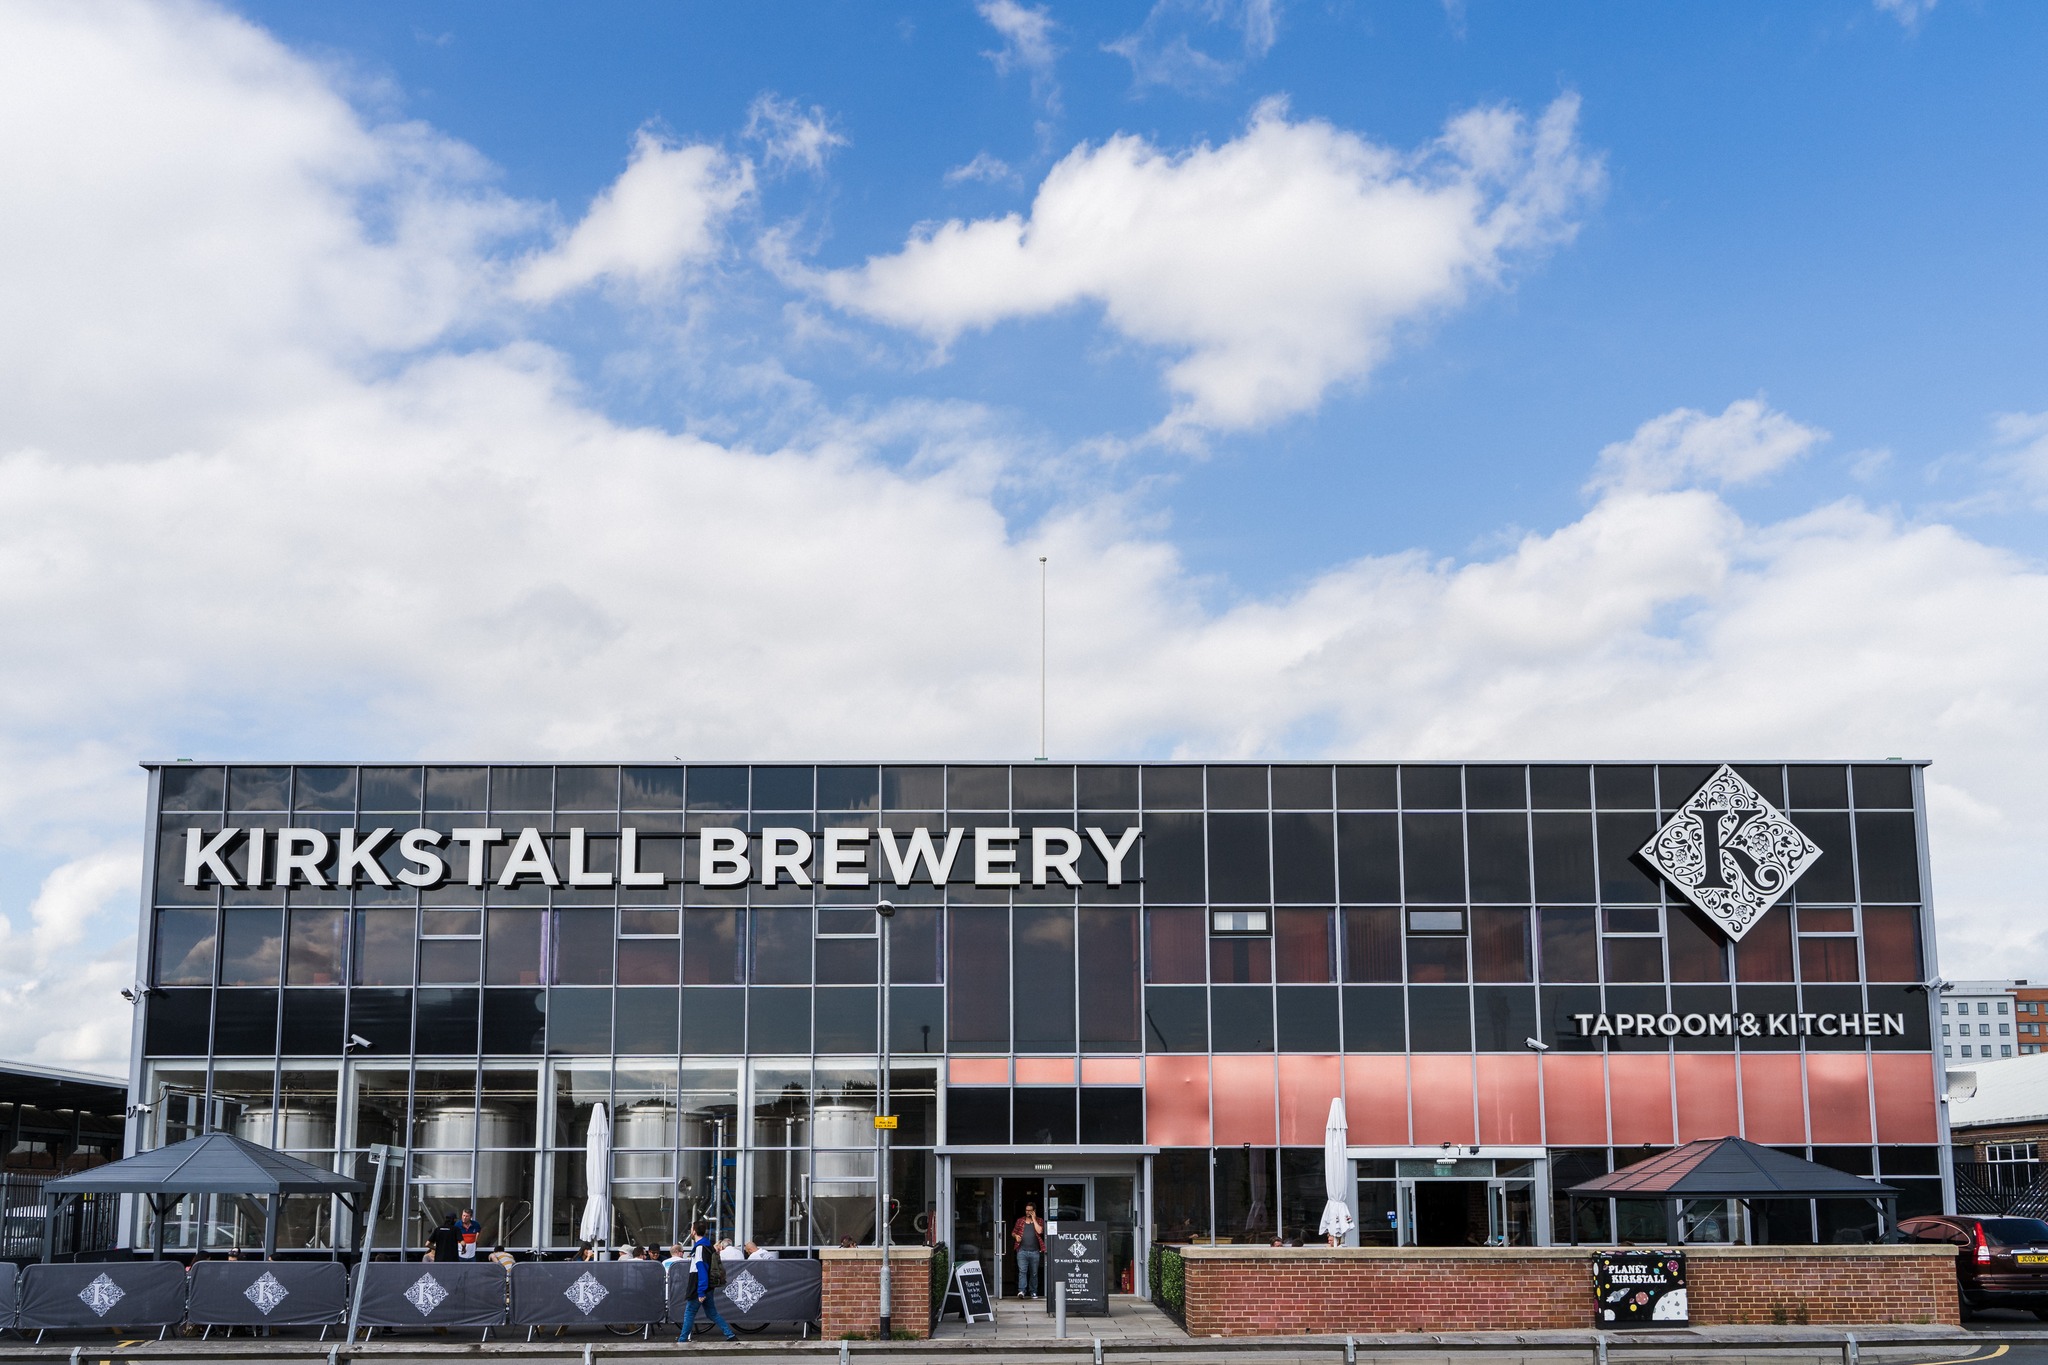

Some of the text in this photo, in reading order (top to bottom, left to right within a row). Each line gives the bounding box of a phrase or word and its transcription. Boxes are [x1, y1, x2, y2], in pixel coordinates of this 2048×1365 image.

[184, 827, 1142, 887] KIRKSTALL BREWERY
[1574, 1012, 1905, 1037] TAPROOM & KITCHEN
[1057, 1233, 1098, 1241] WELCOME
[1608, 1265, 1648, 1274] PLANET
[1611, 1274, 1668, 1284] KIRKSTALL
